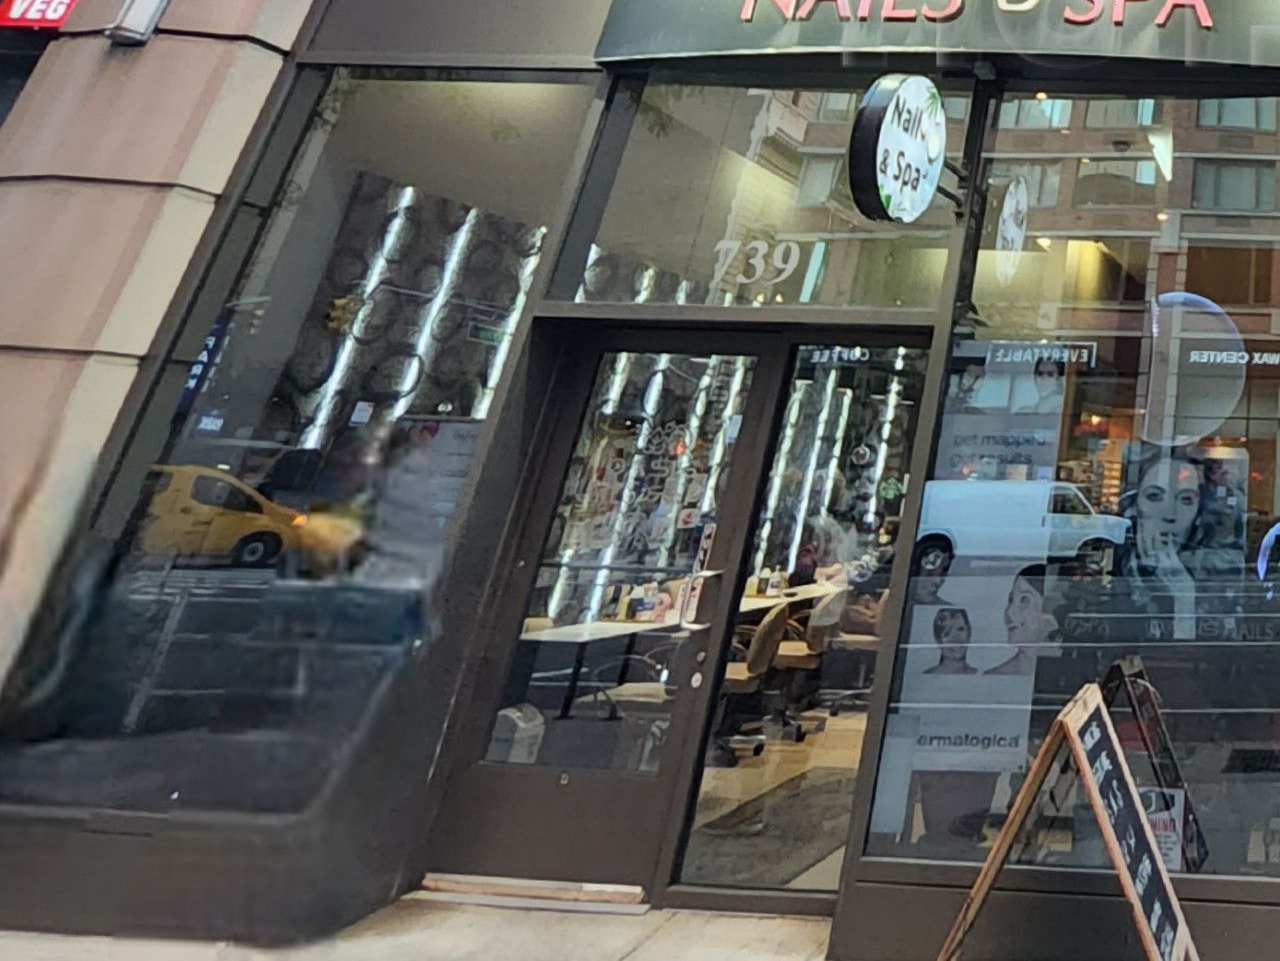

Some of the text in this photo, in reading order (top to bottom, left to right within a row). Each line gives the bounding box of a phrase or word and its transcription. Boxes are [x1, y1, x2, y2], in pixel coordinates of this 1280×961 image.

[879, 148, 922, 195] & Spa
[713, 240, 801, 285] 739
